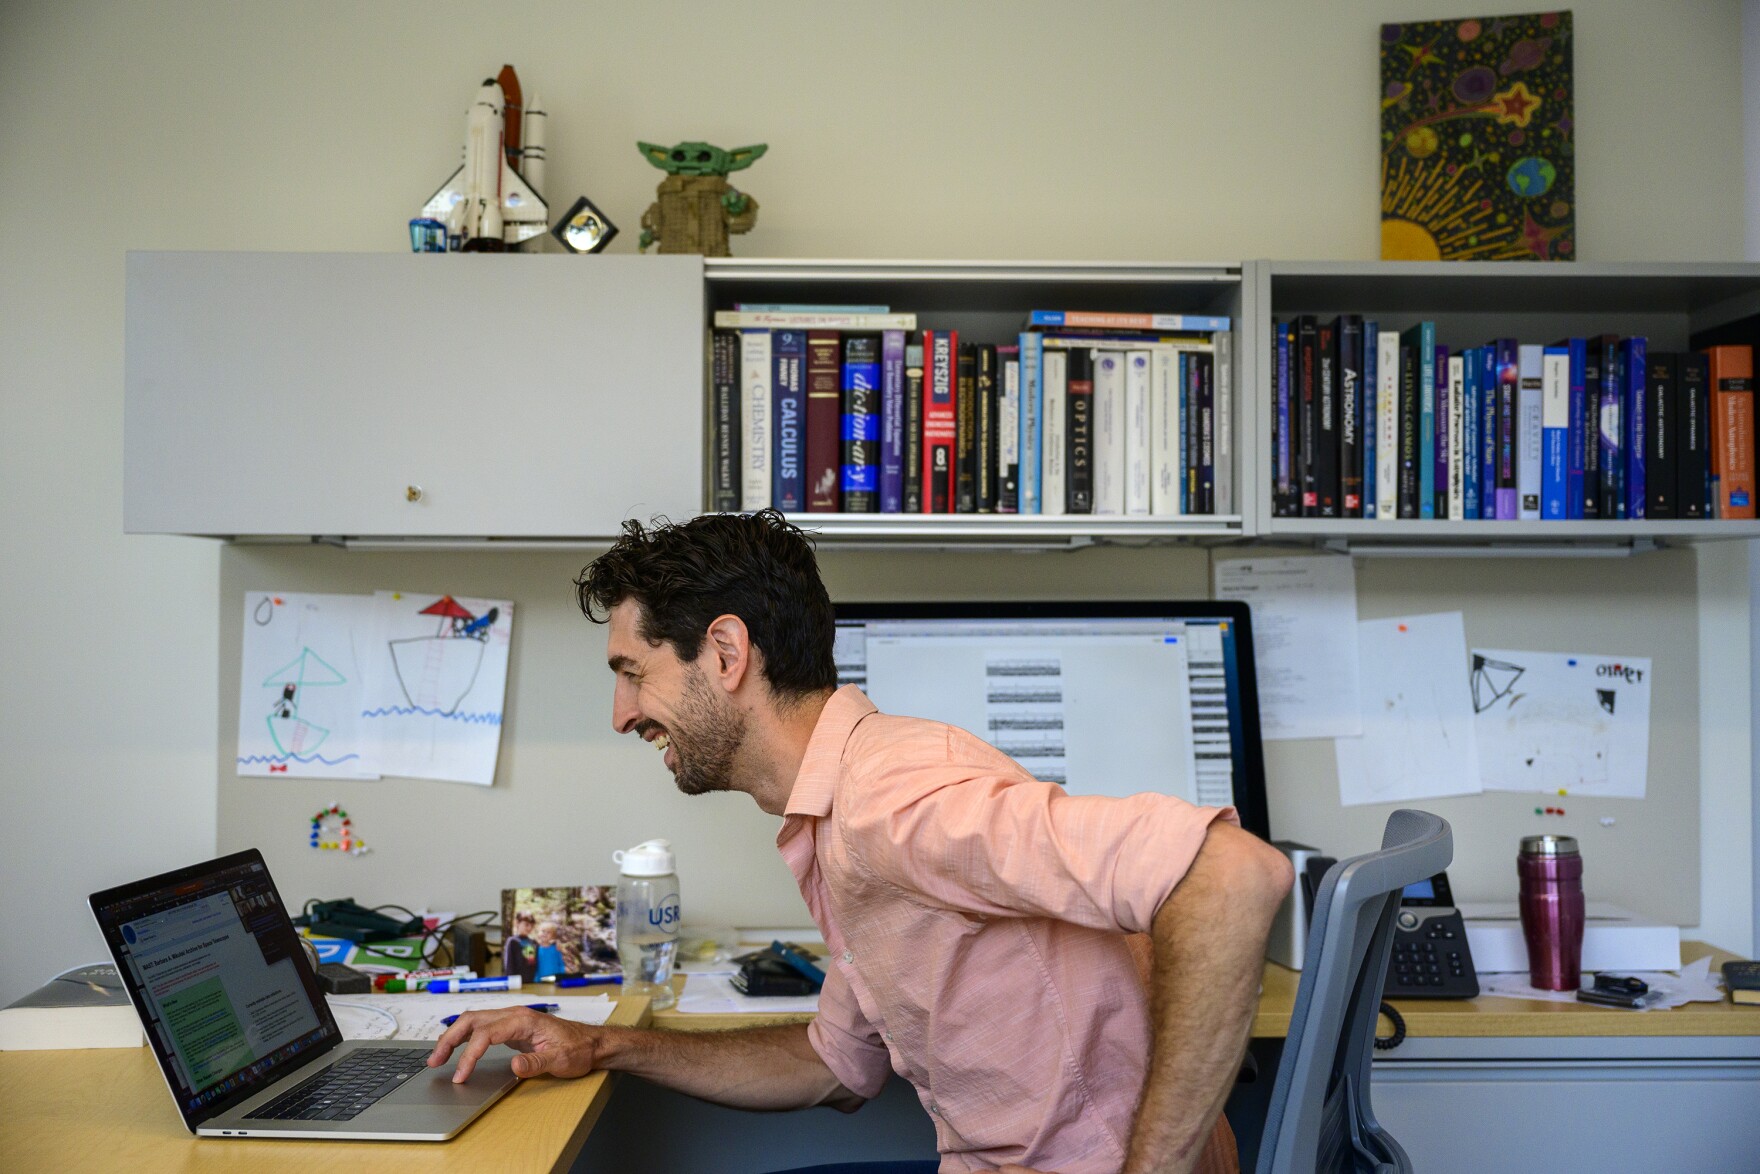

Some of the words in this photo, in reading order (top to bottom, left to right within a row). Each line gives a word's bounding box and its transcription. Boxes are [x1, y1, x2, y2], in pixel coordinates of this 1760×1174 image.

[780, 358, 788, 386] FINNEY
[790, 358, 799, 391] THOMAS
[935, 338, 949, 394] KREYSZIG
[721, 387, 730, 421] HALLIDAY
[1027, 380, 1036, 413] Modern
[1344, 369, 1358, 445] ASTRONOMY
[1404, 372, 1412, 411] LIVING
[1485, 390, 1495, 404] The
[752, 384, 766, 472] CHEMISTRY
[1027, 417, 1036, 450] Physics
[1074, 400, 1086, 467] OPTICS
[1439, 401, 1448, 433] Measure
[1485, 406, 1495, 435] Physics
[781, 398, 798, 479] CALCULUS
[1404, 414, 1412, 459] COSMOS
[1439, 449, 1448, 463] Sky
[1485, 446, 1495, 464] Stars
[721, 460, 730, 488] WALKER
